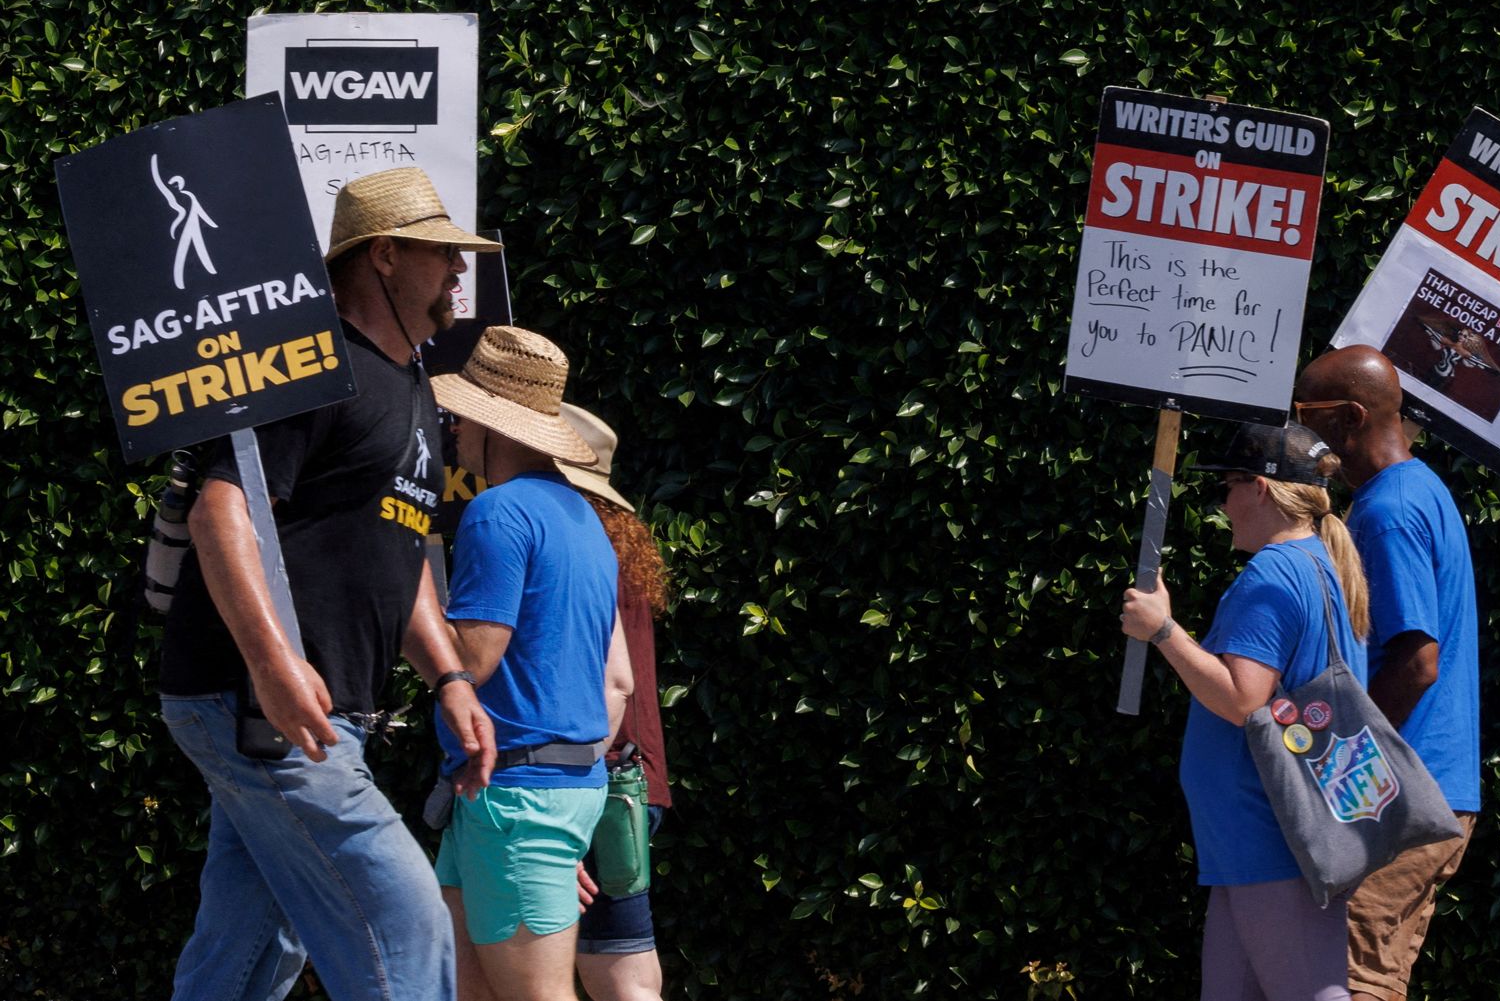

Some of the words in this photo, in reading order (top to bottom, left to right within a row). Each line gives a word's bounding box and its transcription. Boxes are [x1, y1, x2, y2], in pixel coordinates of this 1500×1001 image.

[290, 70, 433, 100] WGAW
[1114, 100, 1230, 145] WRITERS
[1235, 119, 1316, 157] GUILD
[295, 141, 415, 164] AG-AFTRA
[1195, 149, 1221, 171] ON
[1100, 161, 1306, 246] STRIKE!
[1104, 240, 1151, 271] This
[1168, 253, 1186, 277] is
[1200, 258, 1240, 280] the
[1088, 269, 1161, 303] Perfect
[1172, 284, 1216, 312] time
[1235, 289, 1262, 316] for
[1417, 286, 1444, 309] SHE
[1443, 301, 1486, 333] LOOKS
[1484, 328, 1495, 341] A
[1424, 272, 1458, 298] THAT
[1457, 293, 1498, 320] CHEAP
[197, 331, 242, 360] ON
[1081, 319, 1118, 358] you
[1137, 322, 1156, 346] to
[122, 330, 340, 427] STRIKE!
[1332, 763, 1389, 813] NFL
